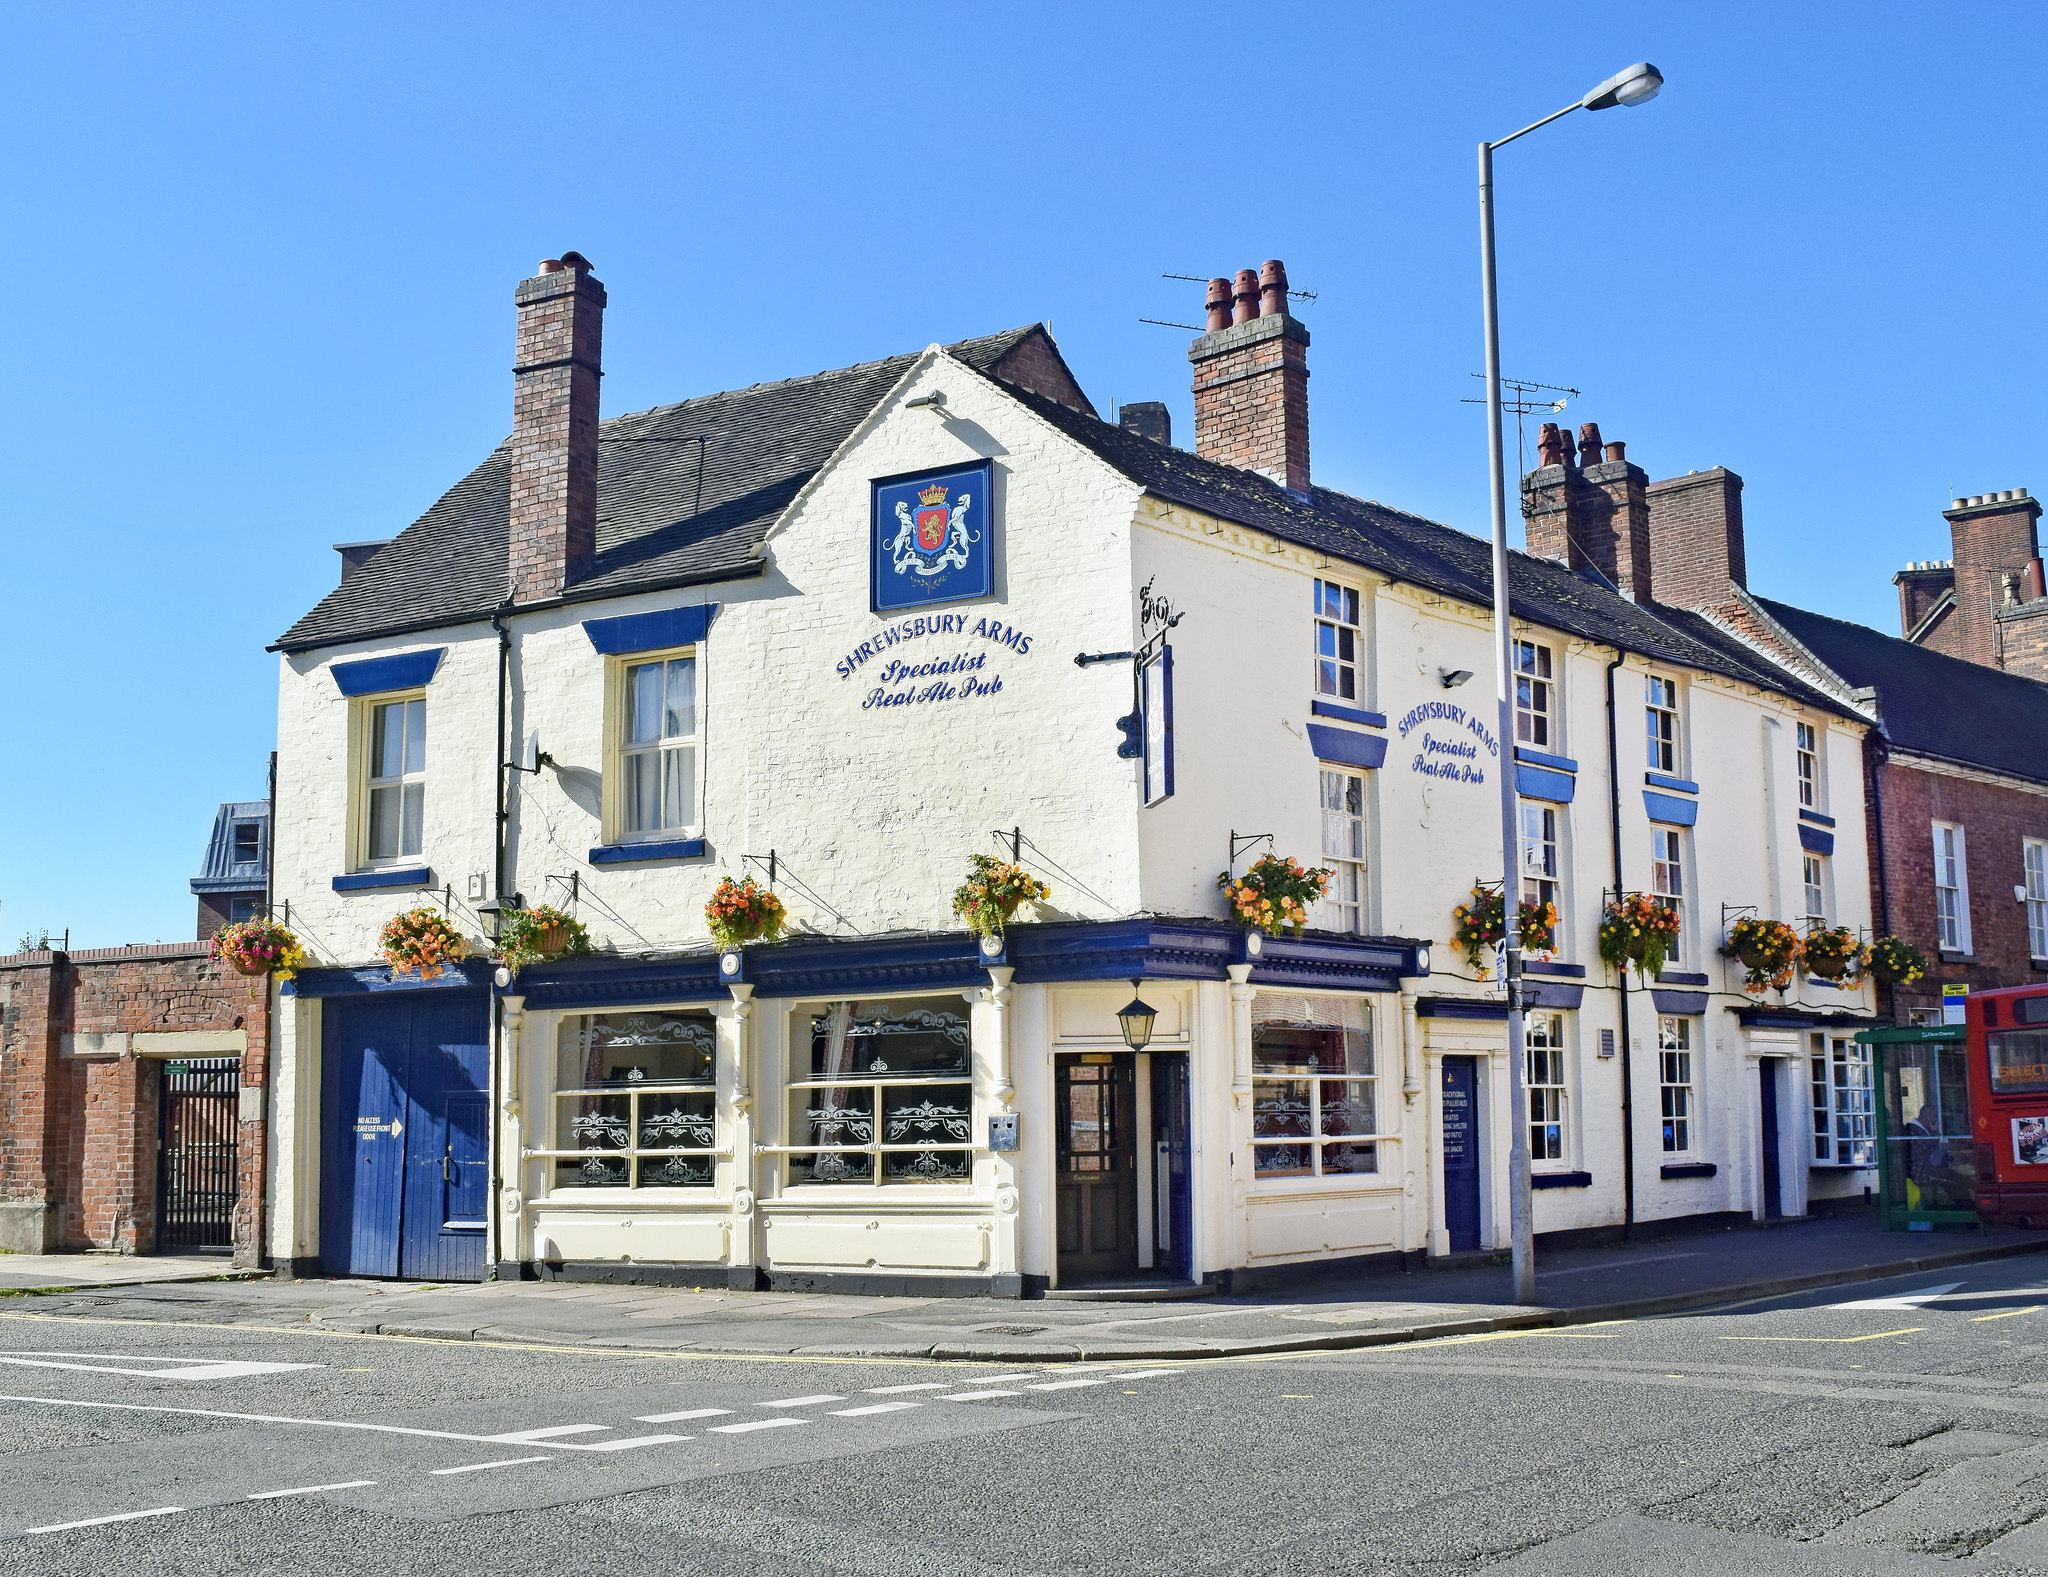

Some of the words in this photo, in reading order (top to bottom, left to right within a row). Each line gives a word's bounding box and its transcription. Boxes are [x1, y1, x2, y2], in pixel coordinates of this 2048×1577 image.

[836, 614, 969, 680] SHREWSBURY
[971, 617, 1033, 656] ARMS
[881, 652, 986, 686] Specialist
[862, 685, 916, 709] Real
[917, 681, 956, 703] Ale
[958, 674, 1003, 700] Pub
[1398, 701, 1466, 740] SHREWSBURY
[1467, 717, 1499, 757] ARMS
[1422, 733, 1477, 759] Specialist
[1412, 754, 1439, 776] Real
[1440, 762, 1461, 781] Ale
[1462, 764, 1484, 784] Pub
[2000, 1064, 2047, 1077] SELECT
[377, 1124, 391, 1132] FRONT
